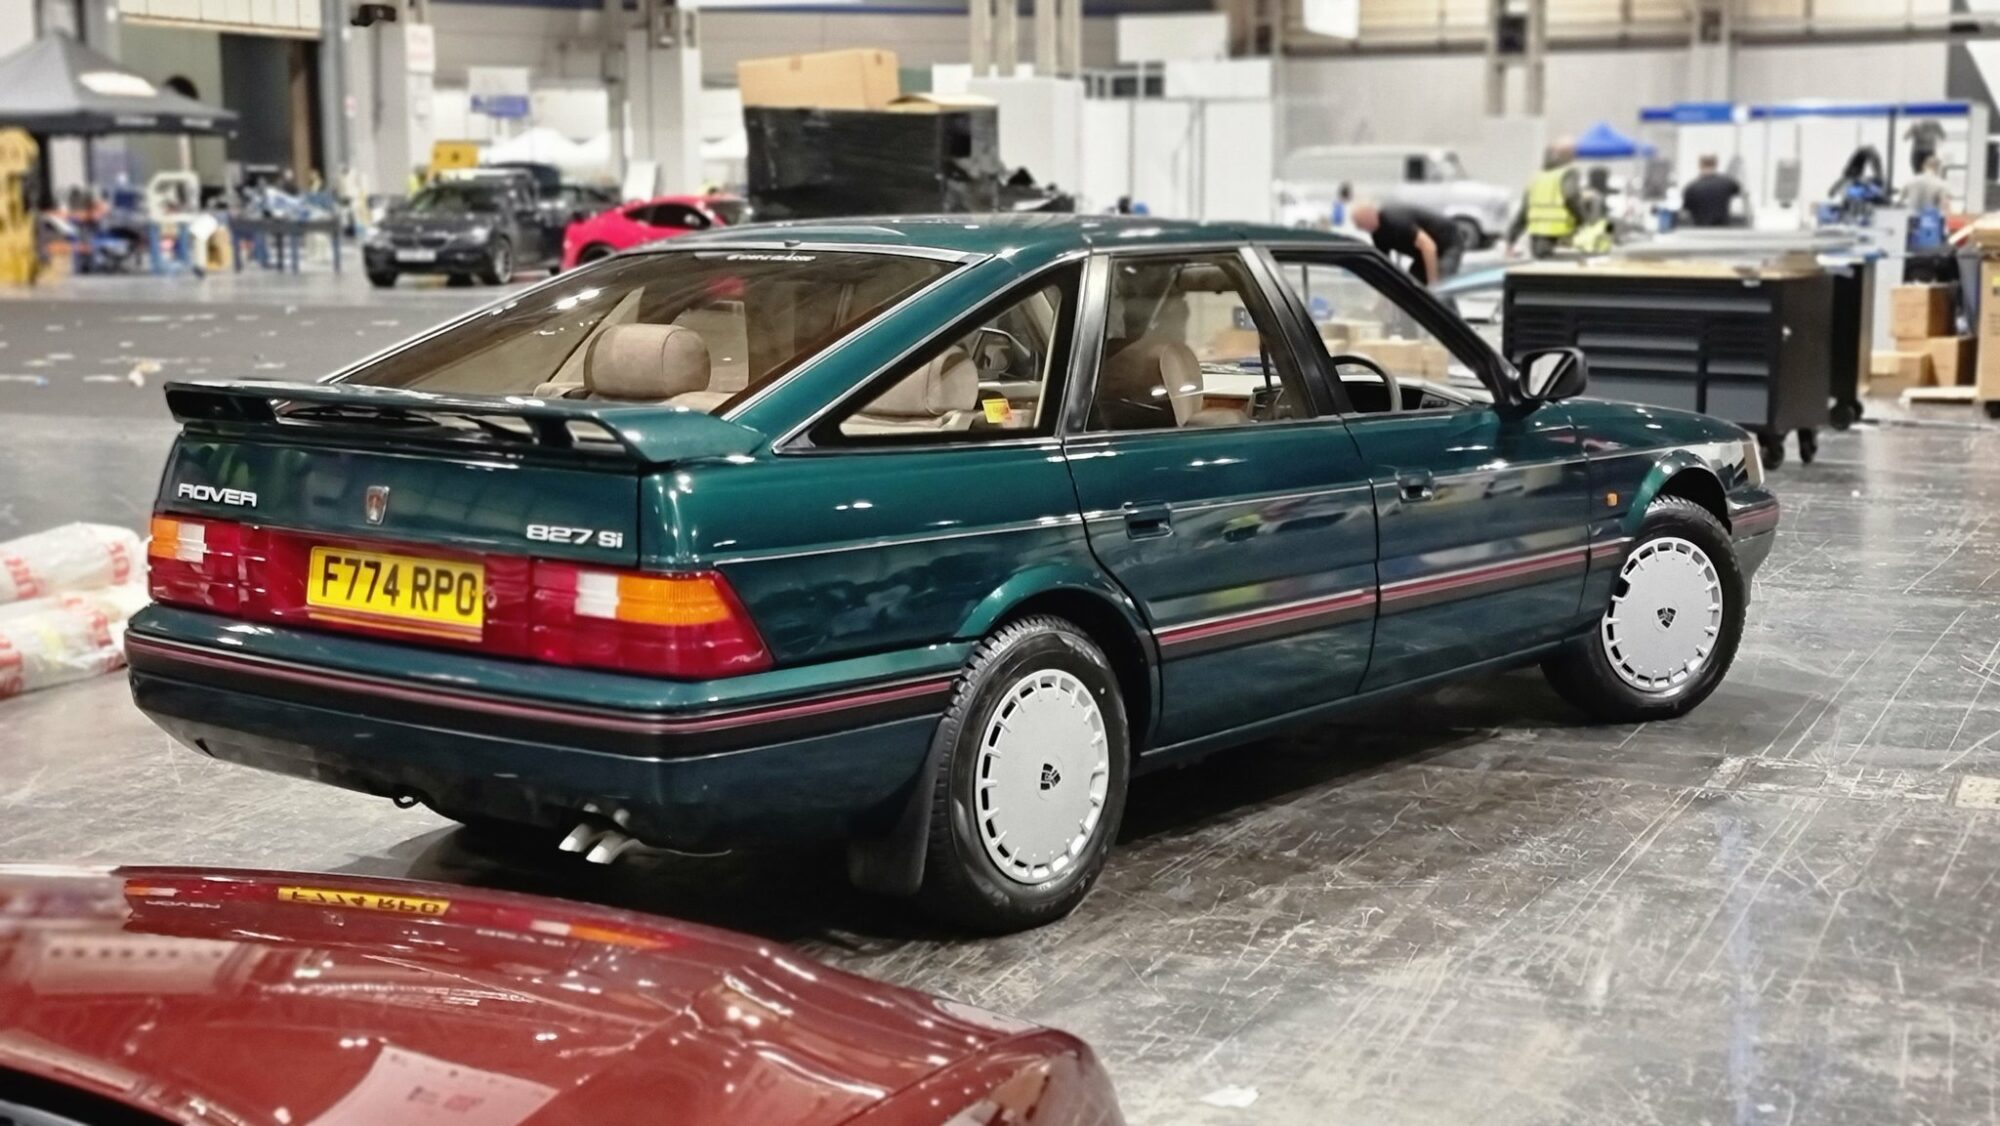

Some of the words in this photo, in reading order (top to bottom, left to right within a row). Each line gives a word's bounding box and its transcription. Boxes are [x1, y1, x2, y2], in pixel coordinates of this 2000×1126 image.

[178, 483, 257, 507] ROVER
[526, 524, 594, 545] 827
[598, 530, 623, 548] Si
[322, 555, 400, 607] F774
[410, 566, 477, 616] RPO
